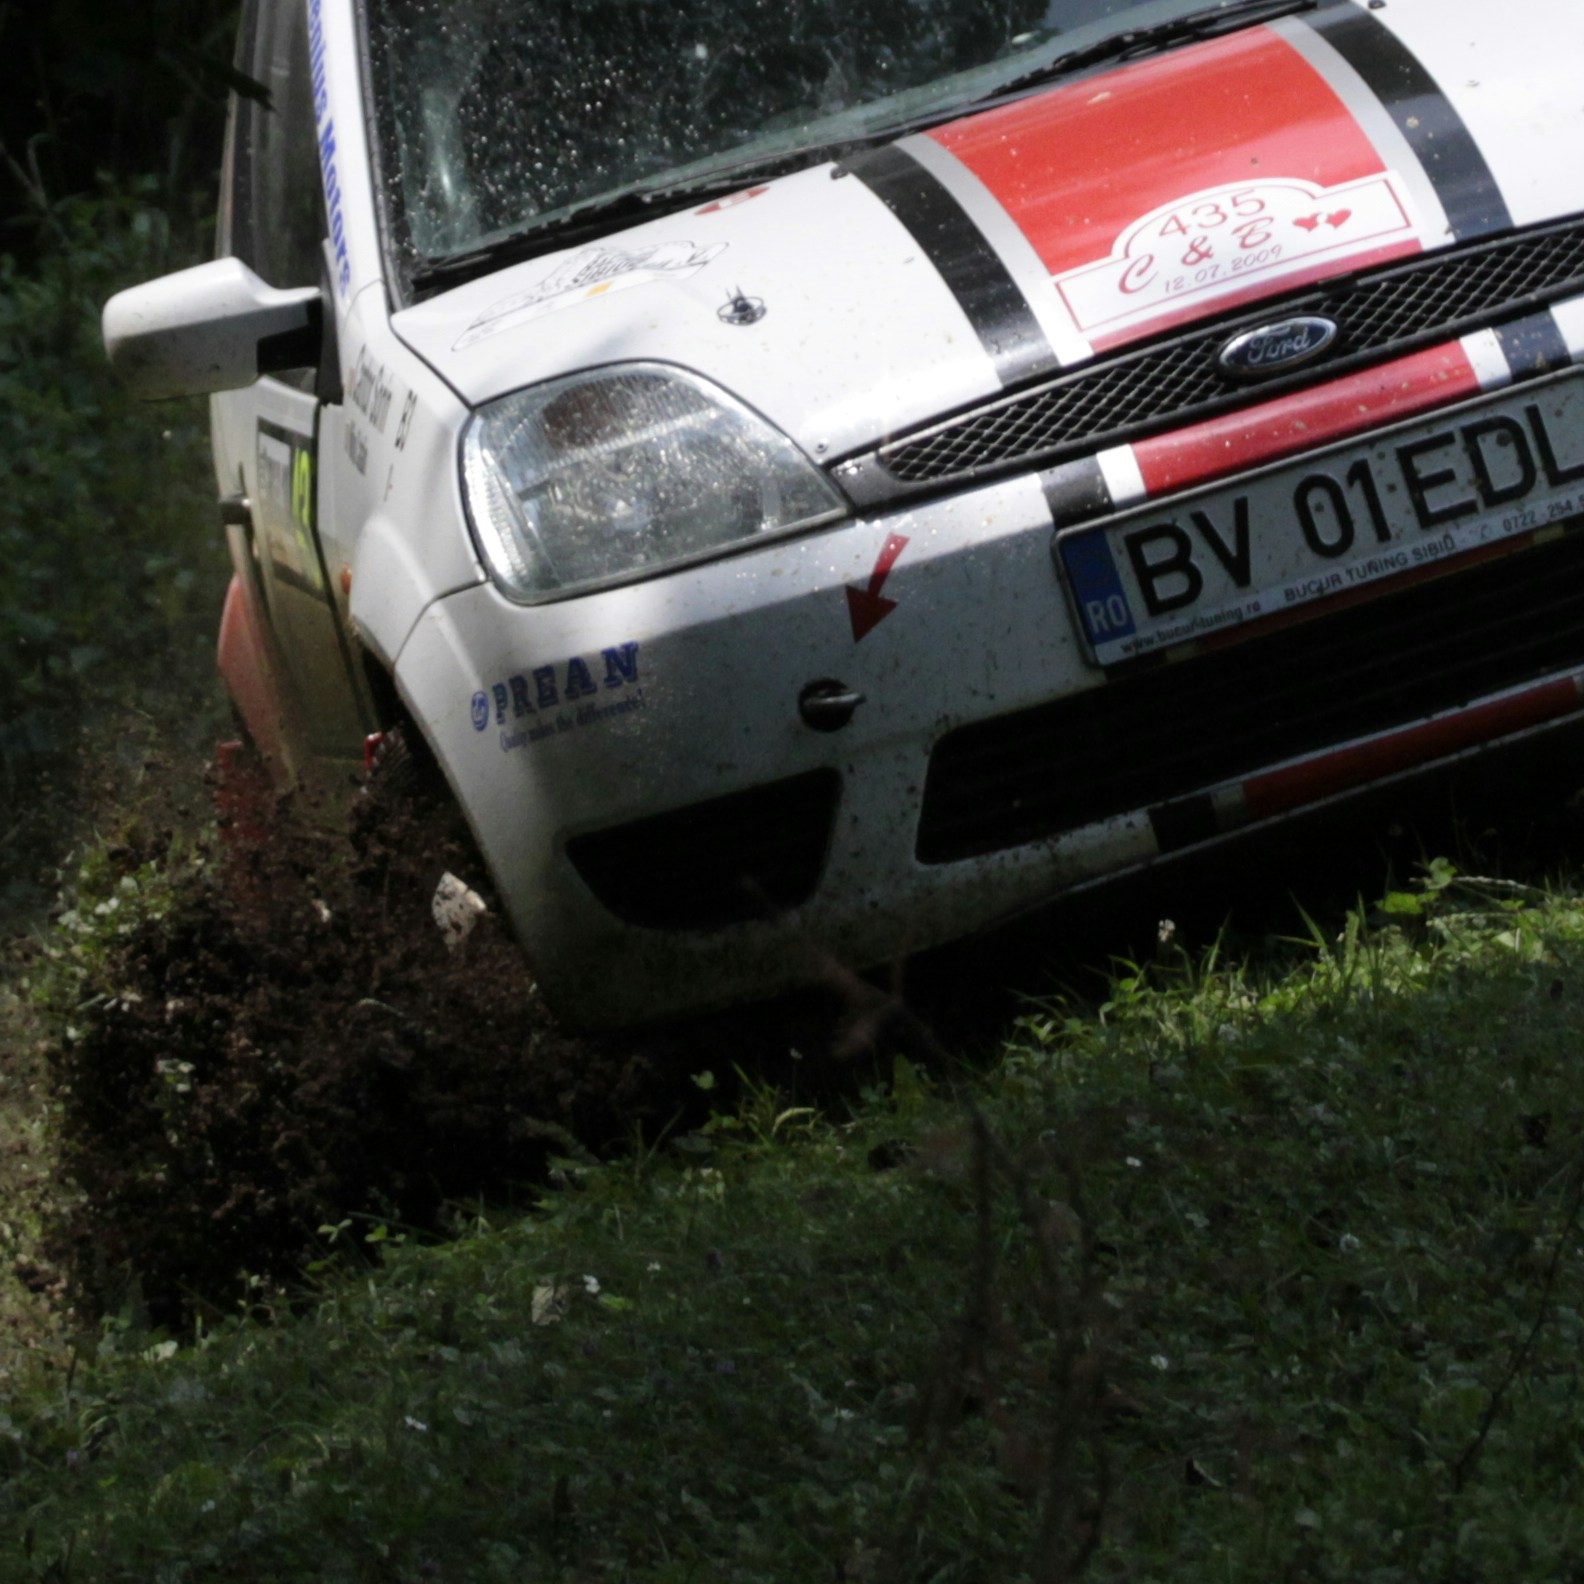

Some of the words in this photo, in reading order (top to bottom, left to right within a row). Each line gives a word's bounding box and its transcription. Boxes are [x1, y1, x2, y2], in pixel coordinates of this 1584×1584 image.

[319, 118, 350, 292] Motors
[1158, 189, 1266, 238] 435
[1118, 252, 1157, 296] C
[1180, 236, 1216, 267] &
[1164, 244, 1282, 294] 12.07.2009
[1247, 324, 1311, 365] Ford
[1124, 496, 1252, 616] BV
[1284, 573, 1342, 602] BUCUR
[1346, 553, 1409, 590] TUNING
[1087, 595, 1127, 634] RO
